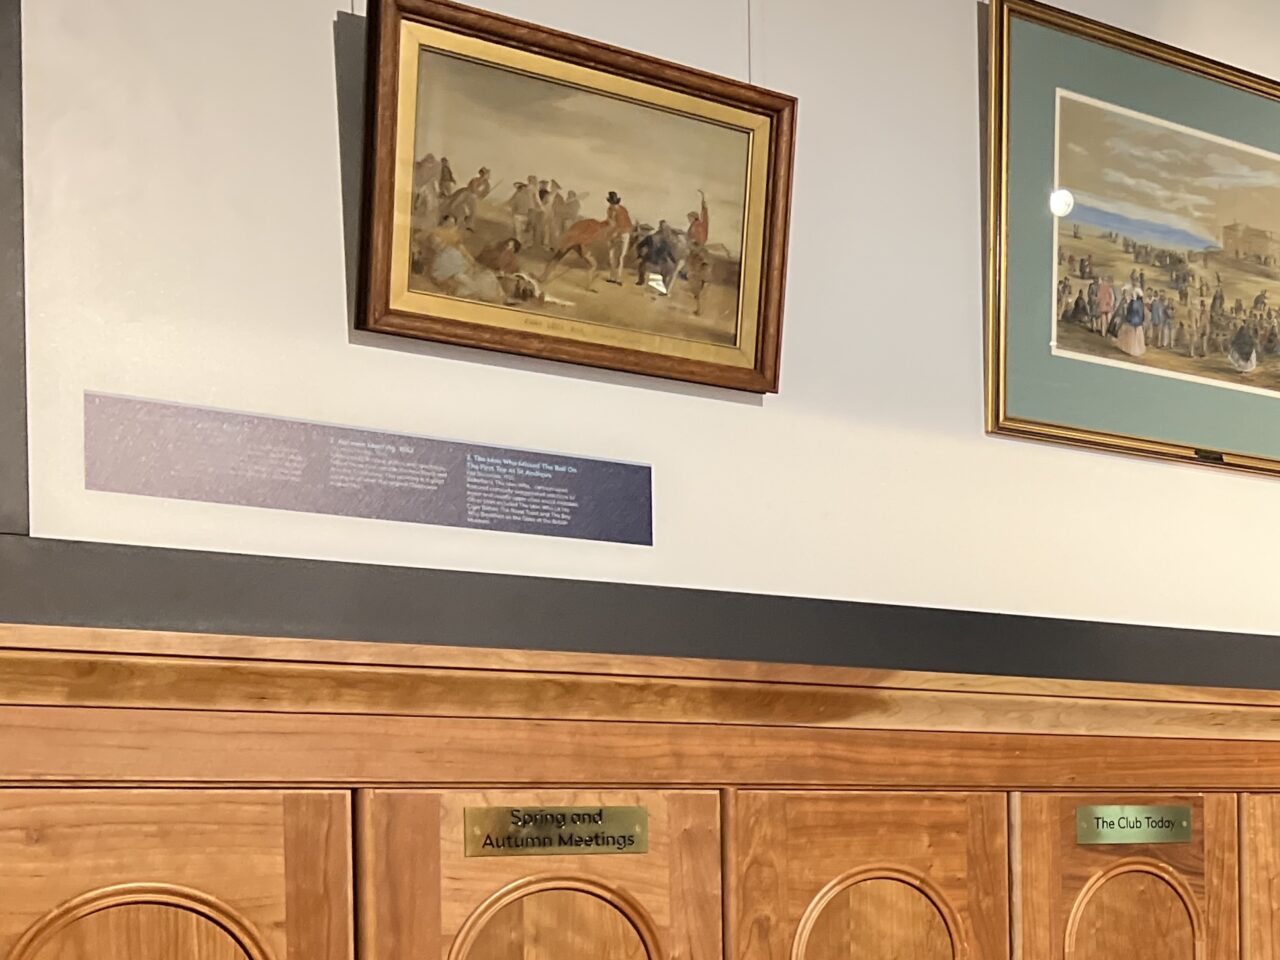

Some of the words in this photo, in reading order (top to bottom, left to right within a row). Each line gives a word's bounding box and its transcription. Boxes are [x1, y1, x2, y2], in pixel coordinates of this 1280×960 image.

[511, 809, 566, 829] Spring
[571, 809, 603, 825] and
[1094, 816, 1115, 829] The
[1117, 816, 1142, 829] Club
[1144, 816, 1177, 831] Today
[482, 833, 553, 849] Autumn
[558, 832, 635, 850] Meetings
